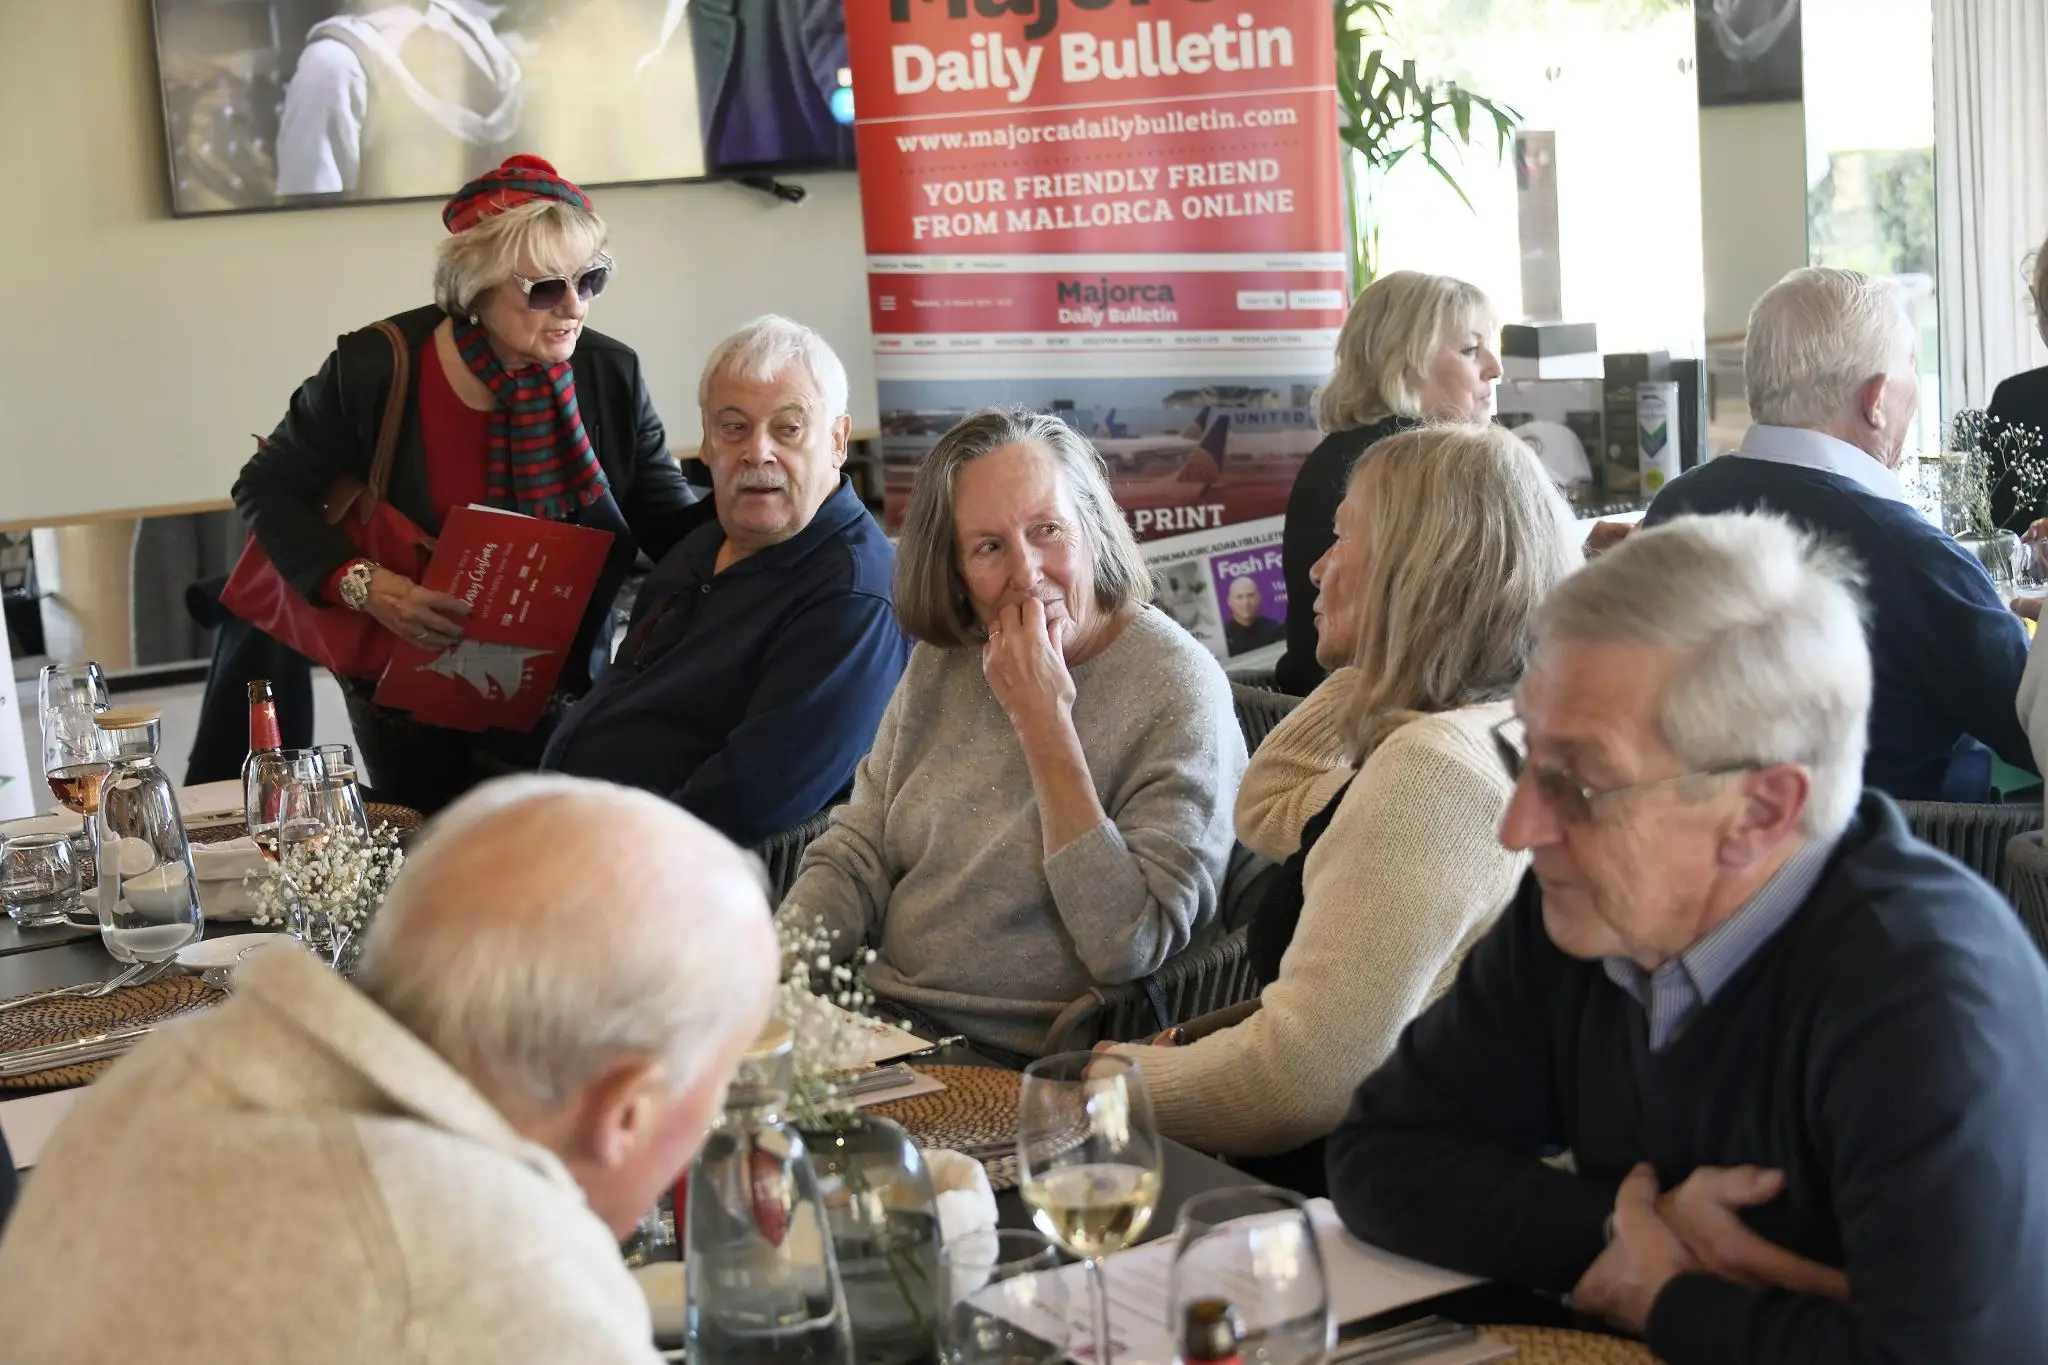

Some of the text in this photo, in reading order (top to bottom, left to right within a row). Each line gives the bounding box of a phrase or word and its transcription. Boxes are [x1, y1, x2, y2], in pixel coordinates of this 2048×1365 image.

[891, 32, 1043, 103] Daily
[1060, 13, 1295, 83] Bulletin
[895, 106, 1299, 154] www.majorcadailybulletin.com
[922, 158, 1280, 207] YOUR FRIENDLY FRIEND
[912, 189, 1295, 240] FROM MALLORCA ONLINE
[1057, 278, 1175, 307] Majorca
[1058, 305, 1178, 328] Daily Bulletin
[1234, 411, 1306, 425] UNITED
[1134, 503, 1225, 532] PRINT
[1217, 552, 1264, 580] Fosh
